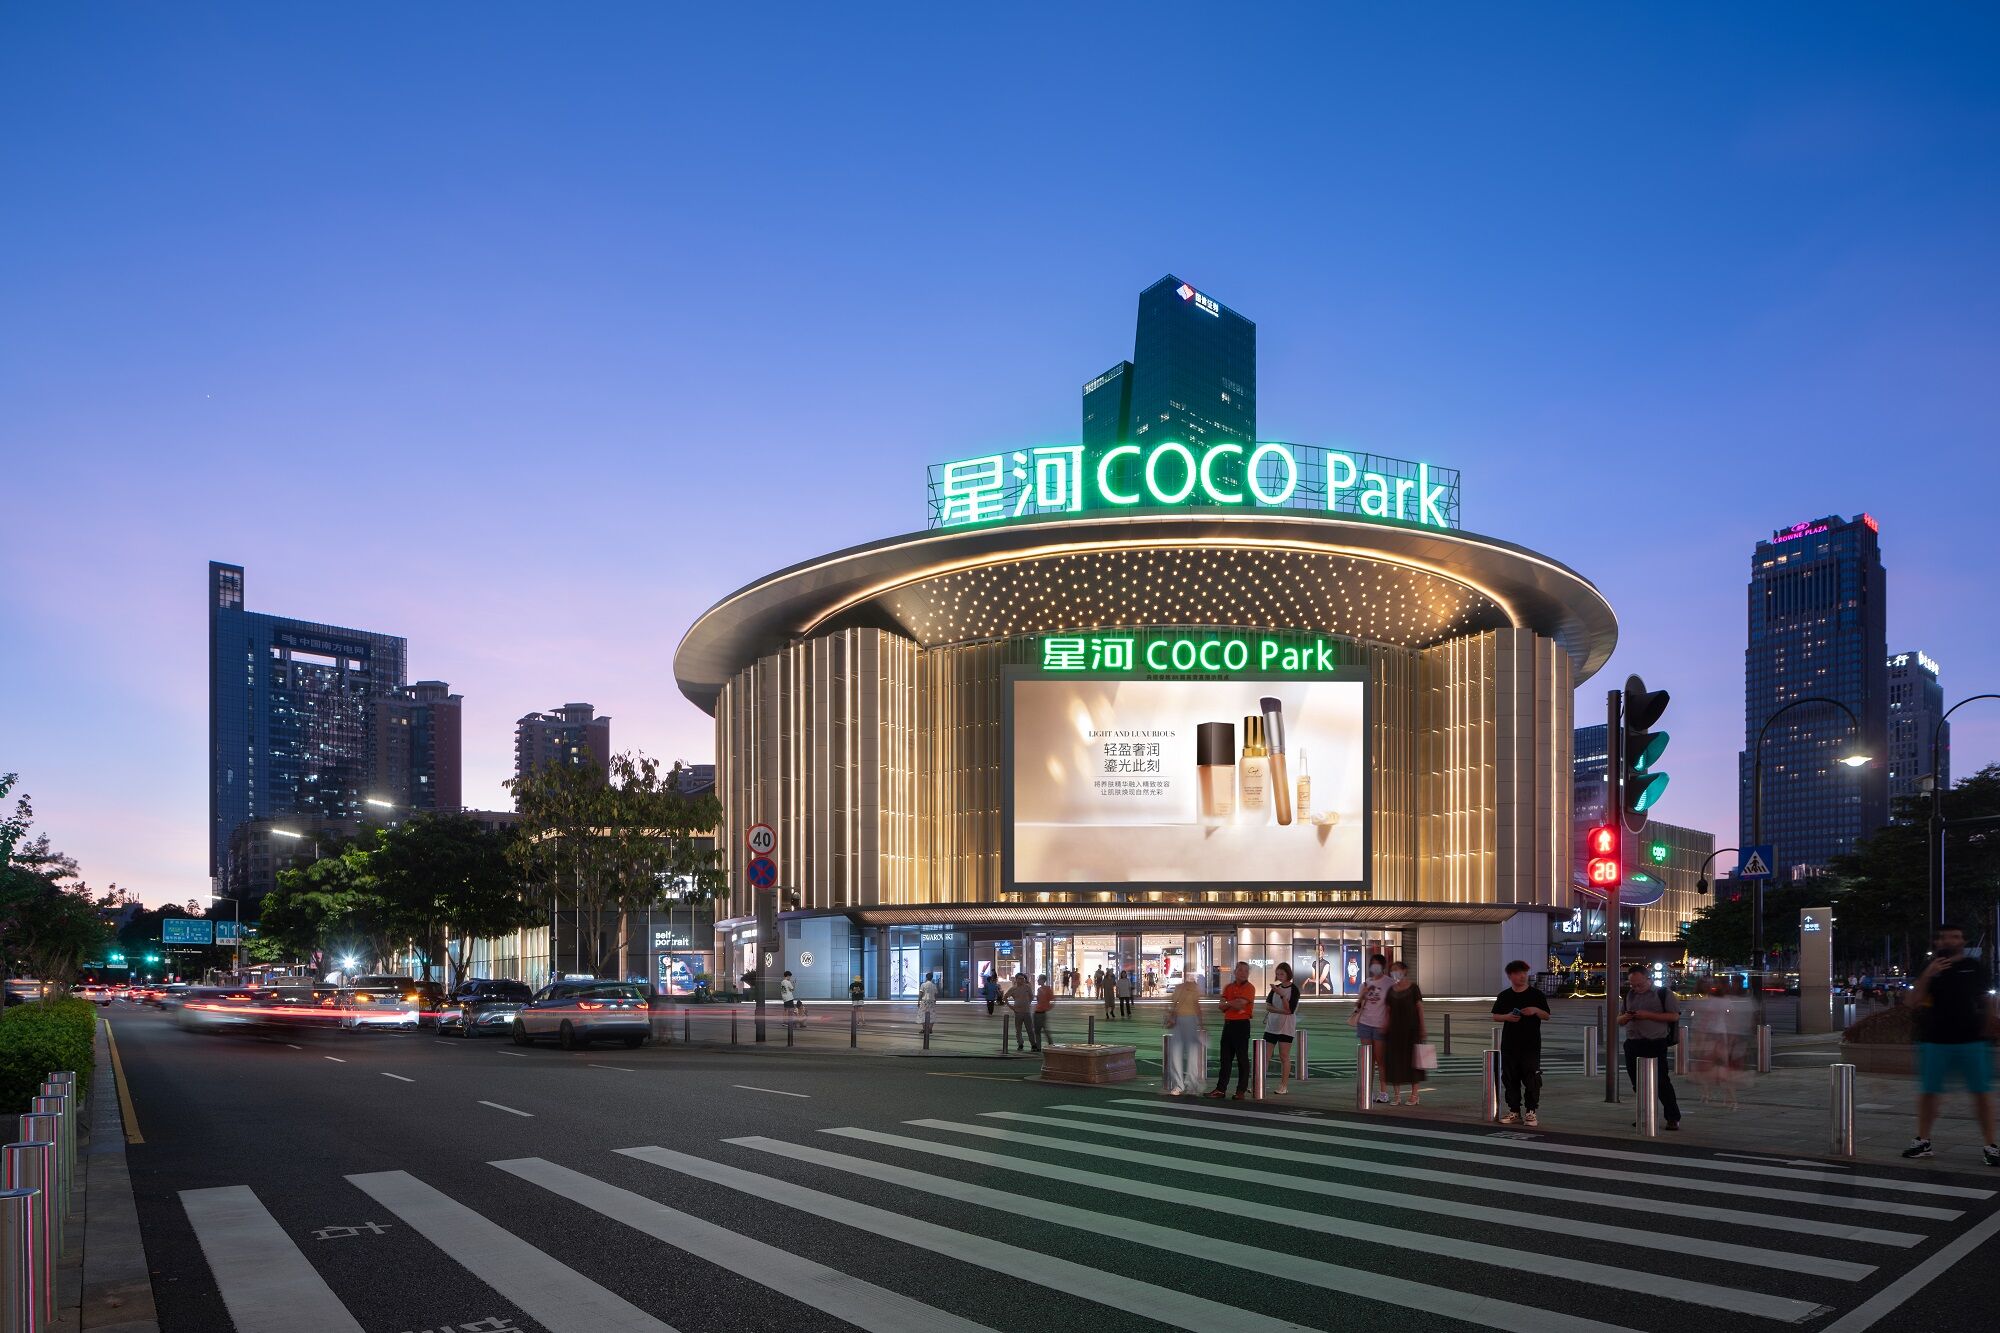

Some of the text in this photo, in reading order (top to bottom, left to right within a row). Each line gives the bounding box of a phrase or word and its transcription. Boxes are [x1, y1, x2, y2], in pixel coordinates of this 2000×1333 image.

[942, 442, 1449, 528] 星河 COCO Park
[1773, 525, 1828, 544] CROWNE PLAZA
[300, 637, 364, 655] 中国南方电网
[1043, 638, 1334, 671] 星河 COCO Park
[1088, 730, 1176, 738] LIGHT AND LUXURIOUS
[1103, 742, 1160, 757] 轻盈奢润
[1103, 758, 1160, 773] 鎏光此刻
[752, 831, 771, 848] 40
[1593, 862, 1617, 881] 28
[655, 930, 675, 940] self-
[655, 938, 690, 948] portrait
